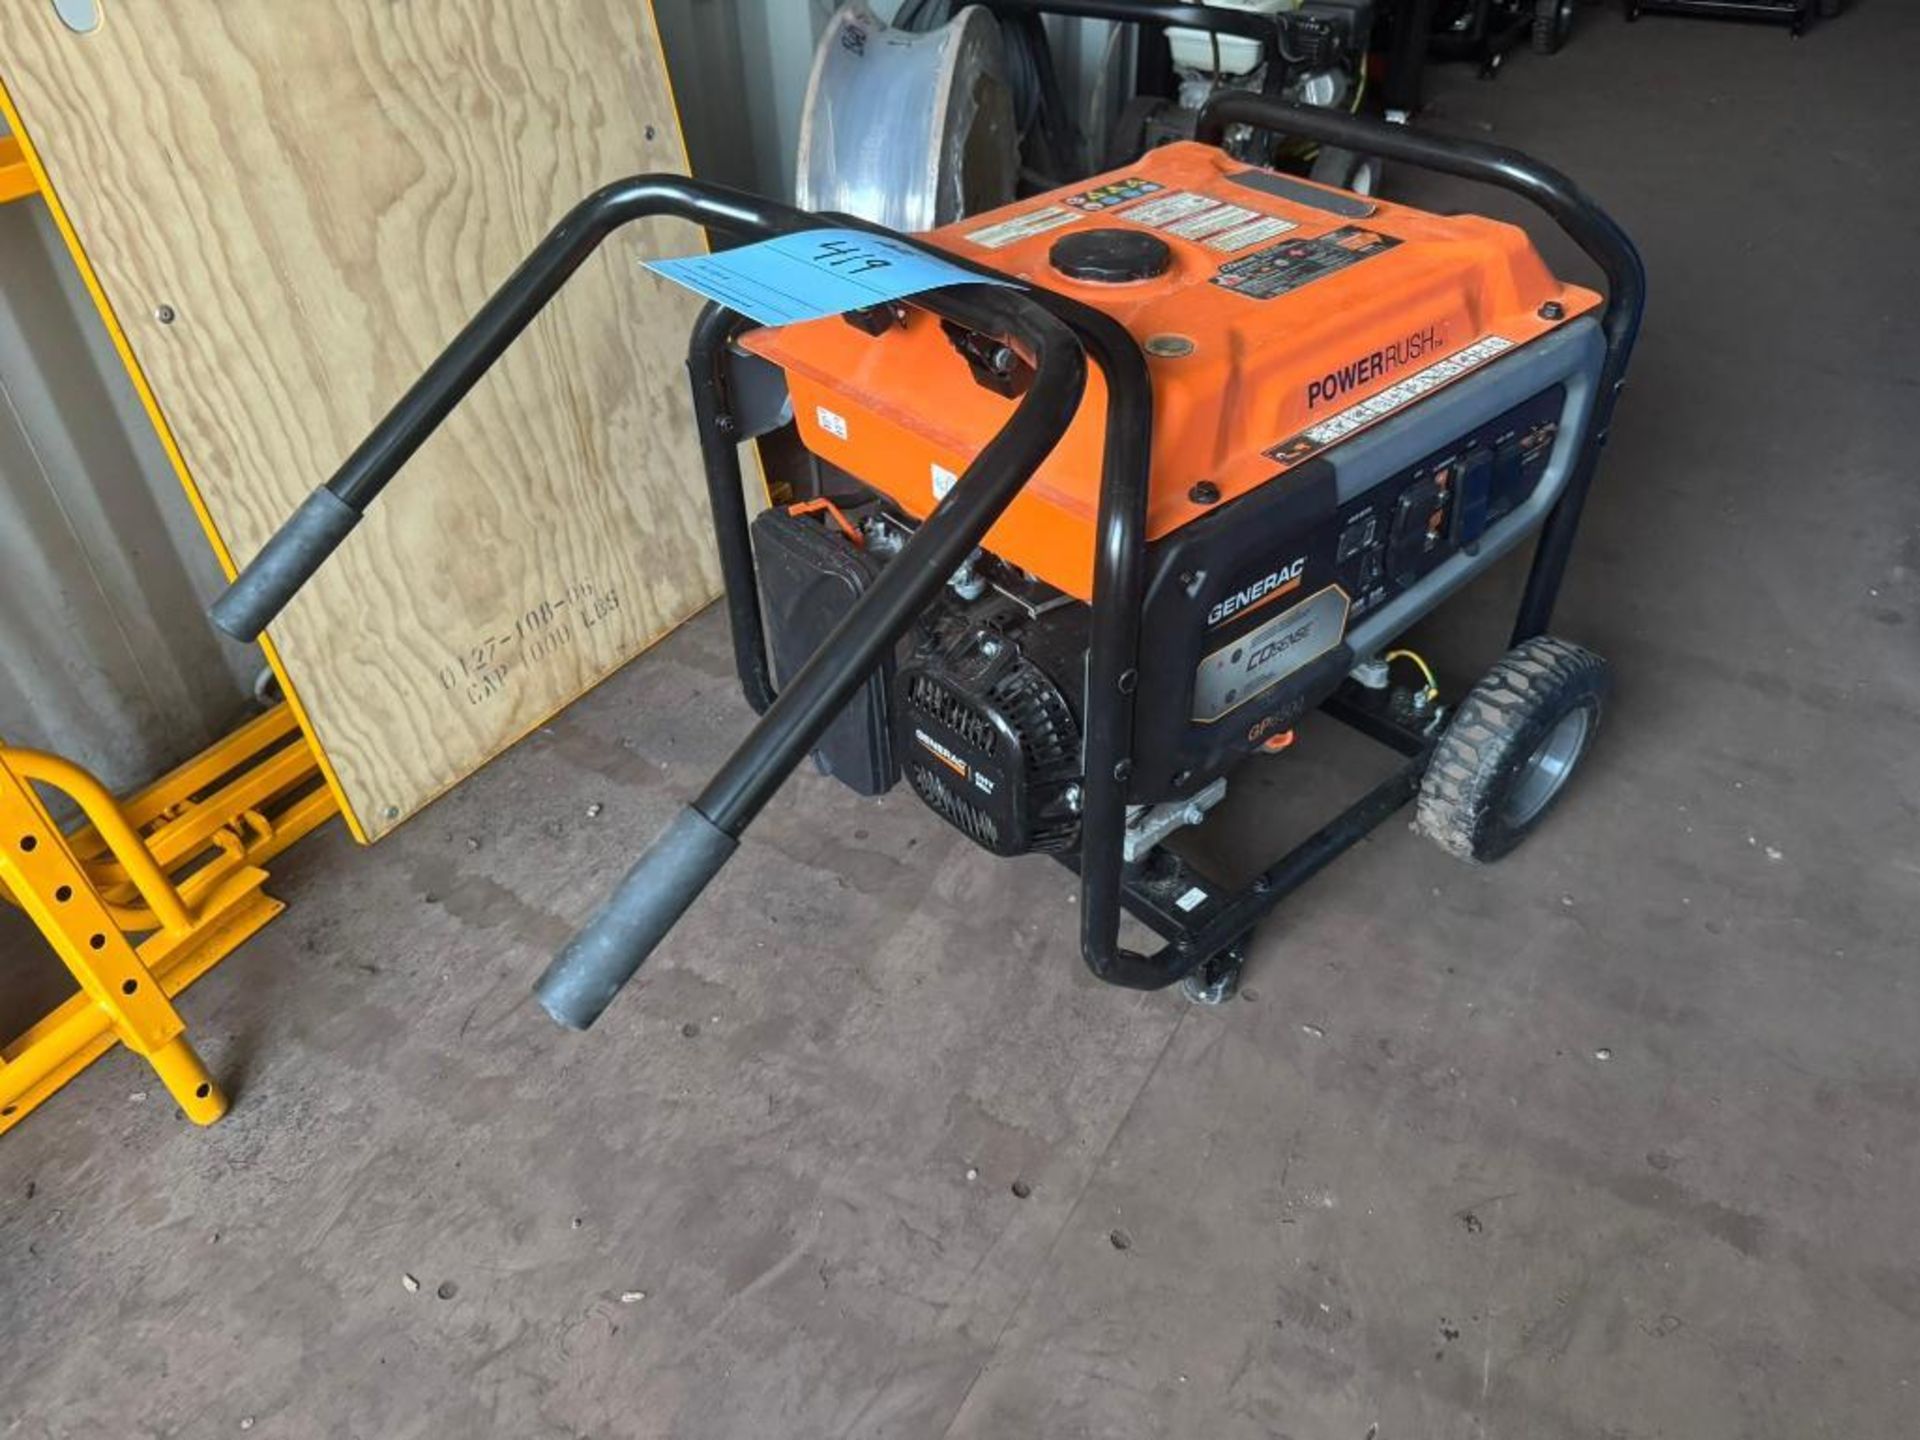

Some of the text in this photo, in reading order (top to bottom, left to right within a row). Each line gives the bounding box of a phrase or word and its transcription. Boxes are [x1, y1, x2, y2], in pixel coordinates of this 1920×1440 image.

[813, 241, 892, 274] 419
[1207, 556, 1307, 626] GENERAC
[466, 662, 509, 705] CAP
